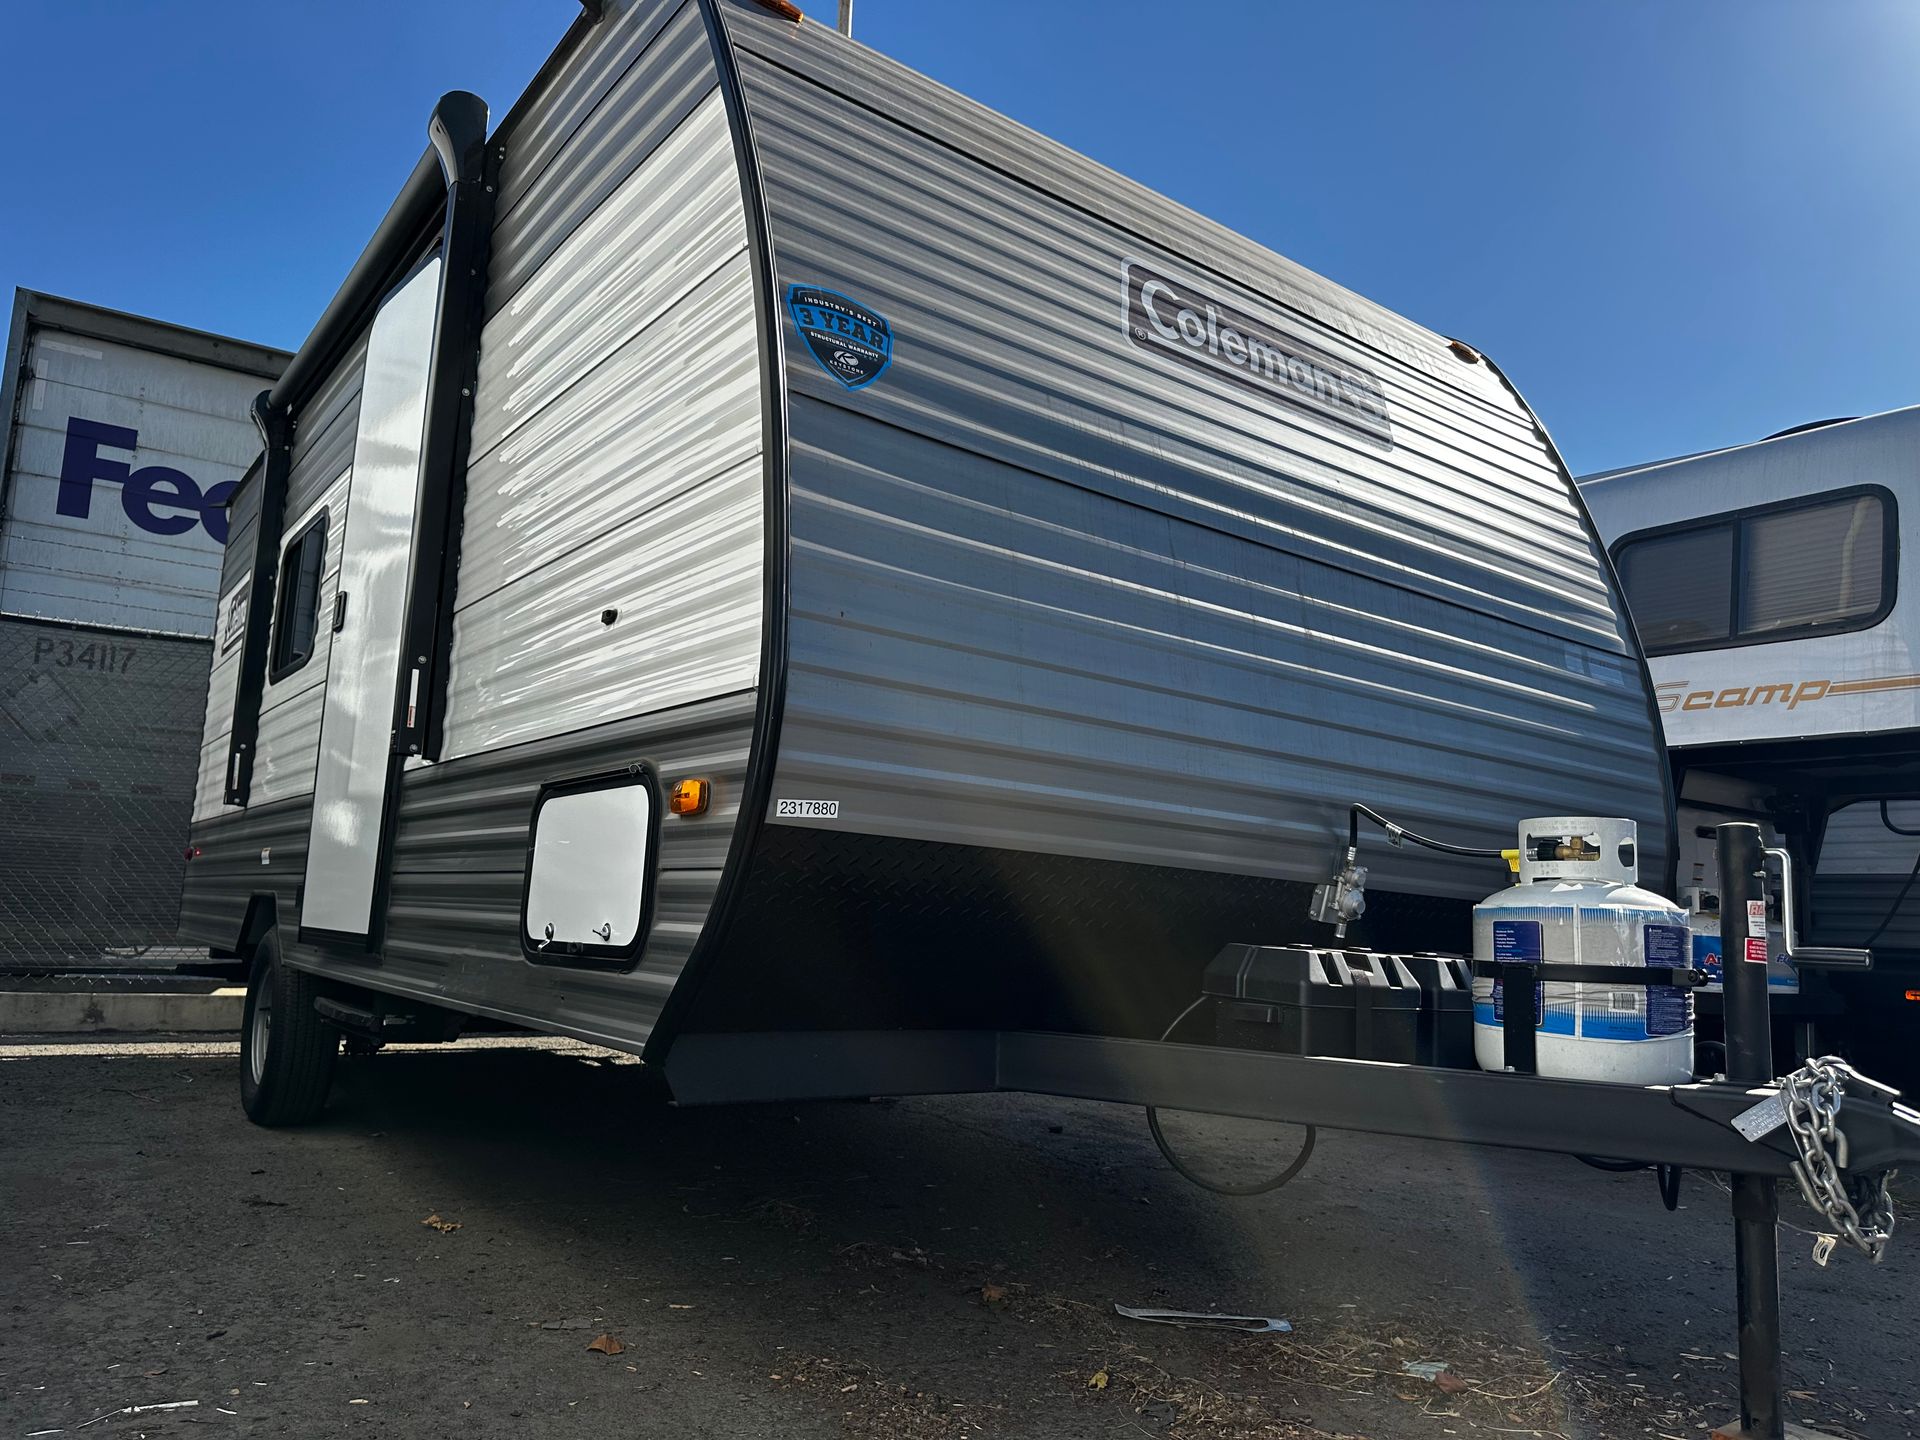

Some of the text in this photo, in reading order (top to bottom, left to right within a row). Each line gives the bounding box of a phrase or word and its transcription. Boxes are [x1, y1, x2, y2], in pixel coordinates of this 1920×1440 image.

[804, 297, 877, 327] INDUSTRY'S BEST
[799, 307, 814, 326] 3
[820, 311, 884, 351] YEAR
[1140, 279, 1341, 407] Coleman
[810, 331, 847, 349] STRUCTURAL
[848, 344, 879, 359] WARRANTY
[780, 801, 837, 816] 2317880
